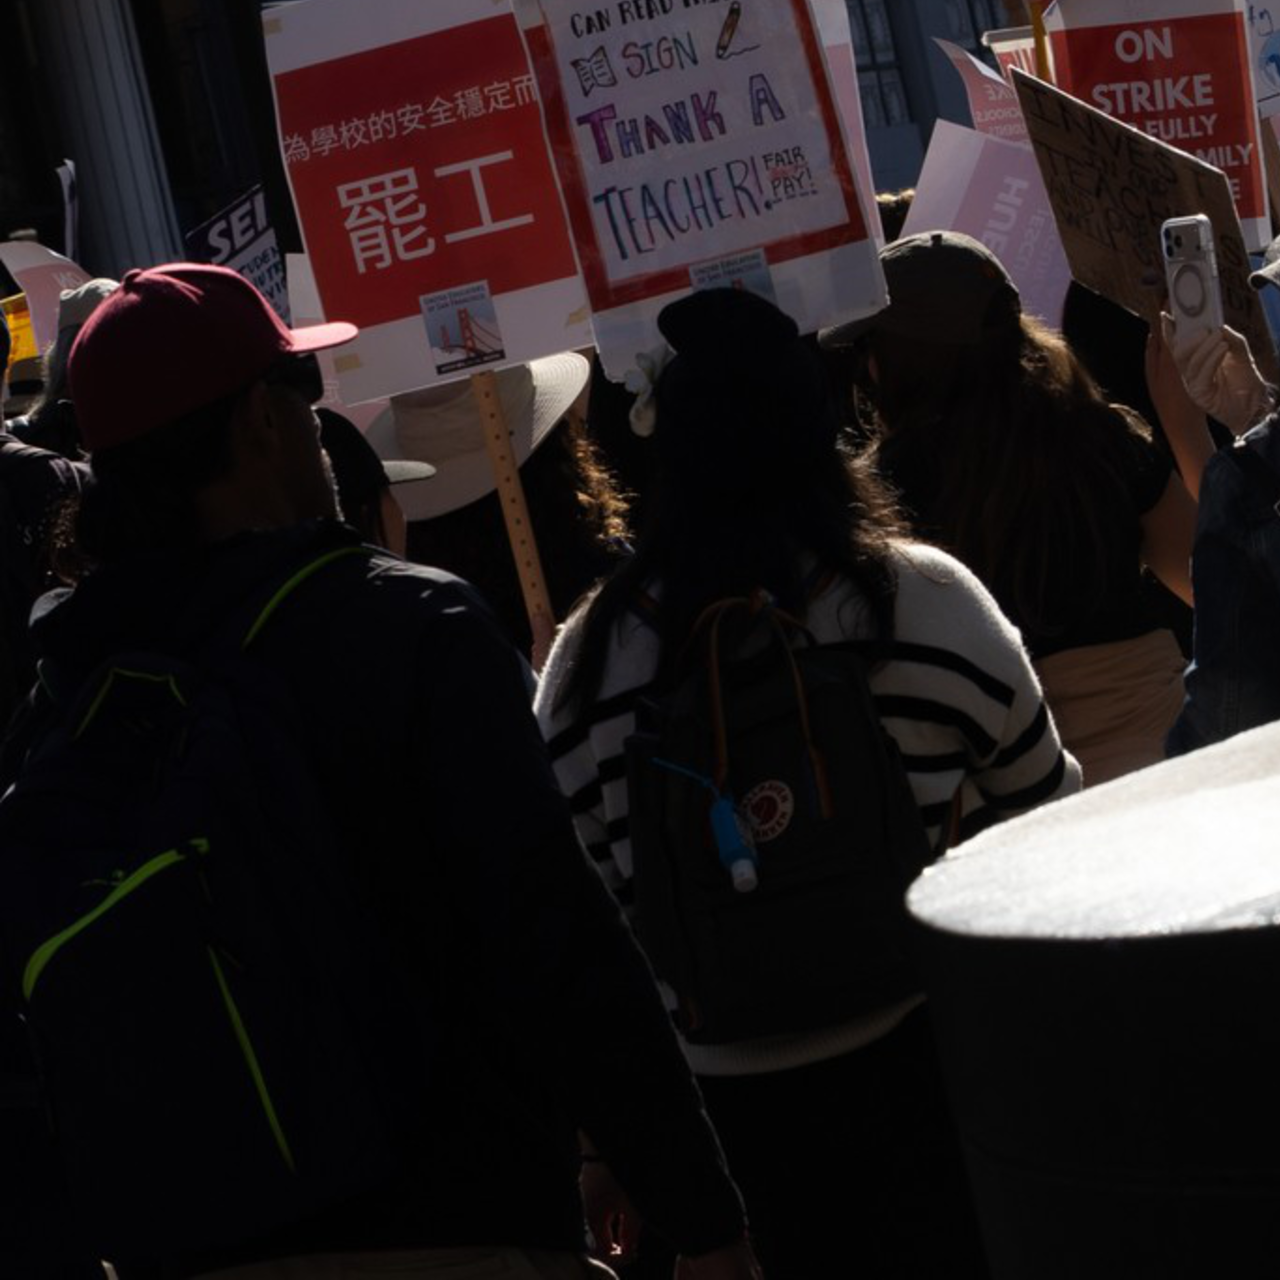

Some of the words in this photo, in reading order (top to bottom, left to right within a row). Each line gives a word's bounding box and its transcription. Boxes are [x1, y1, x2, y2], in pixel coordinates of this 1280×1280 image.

[570, 9, 611, 38] CAN
[1114, 26, 1174, 64] ON
[621, 31, 699, 78] SIGN
[1091, 73, 1215, 116] STRIKE
[284, 72, 539, 166] 為學校的安全穩定而
[576, 90, 727, 164] THANK
[749, 73, 785, 126] A
[1146, 113, 1218, 141] FULLY
[762, 146, 806, 170] FAIR
[1195, 142, 1254, 168] MILY
[771, 167, 816, 197] PAY!
[207, 190, 269, 265] SEI
[335, 149, 535, 275] 罷工
[593, 155, 773, 260] TEACHER!
